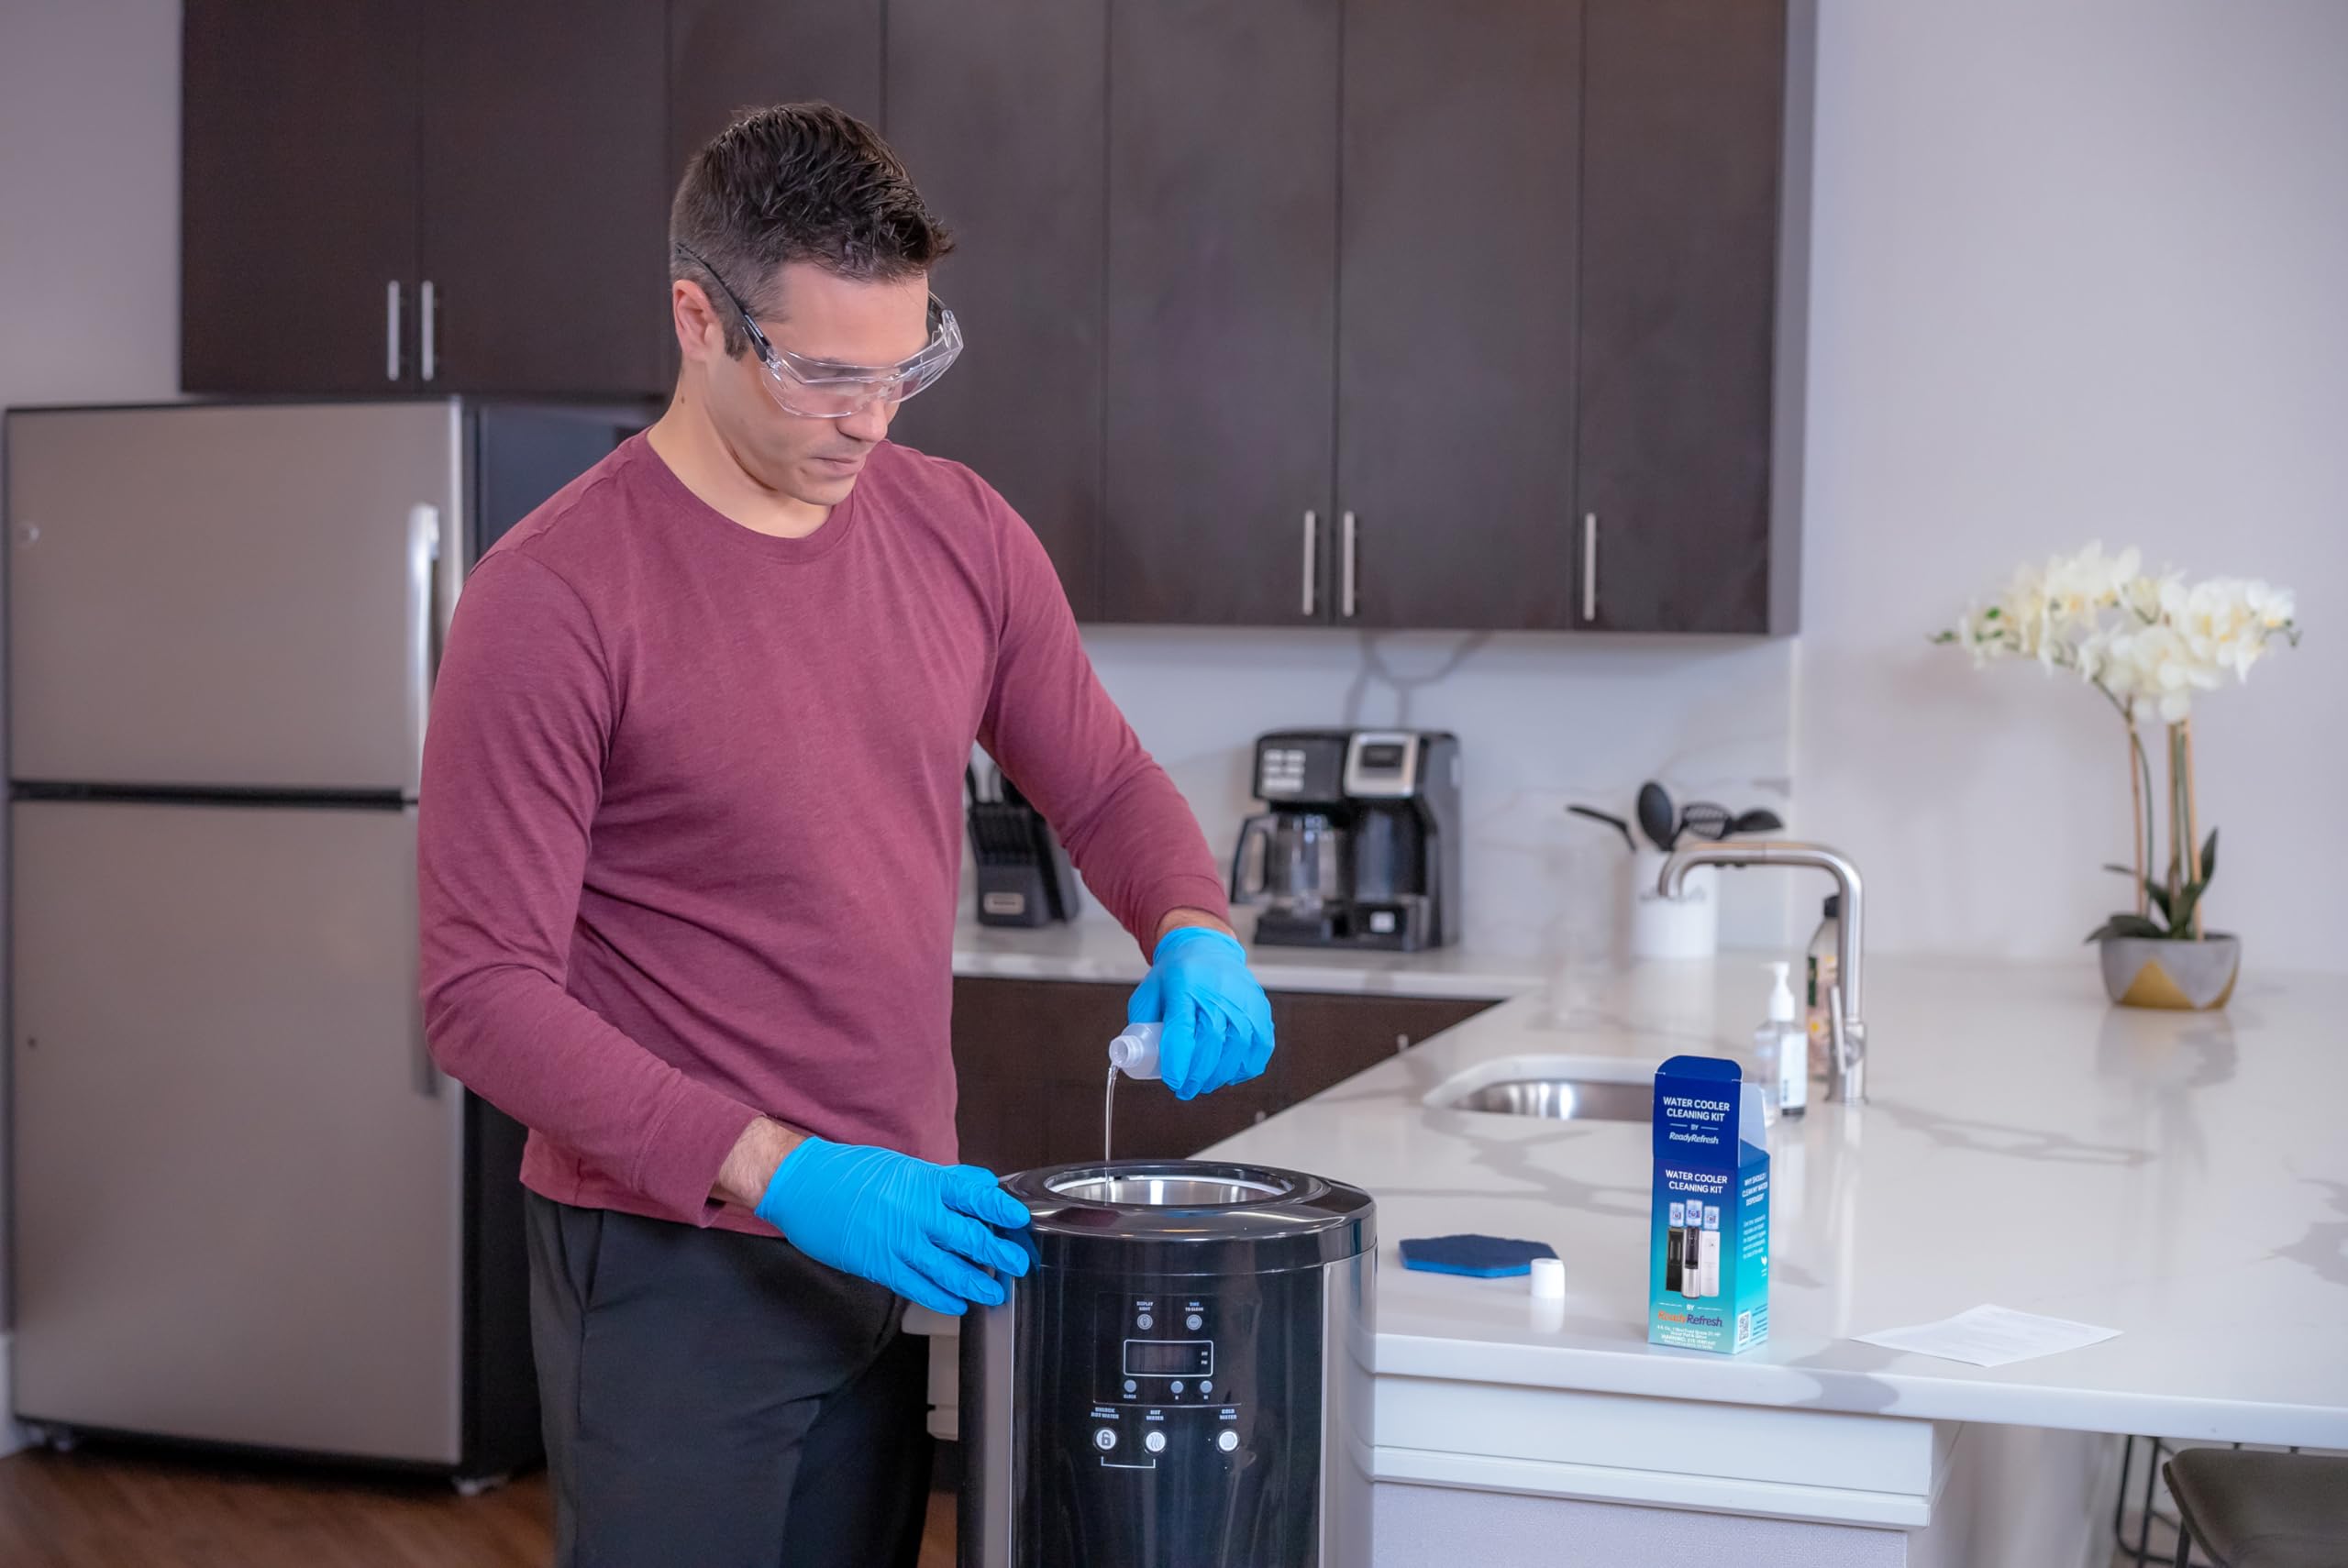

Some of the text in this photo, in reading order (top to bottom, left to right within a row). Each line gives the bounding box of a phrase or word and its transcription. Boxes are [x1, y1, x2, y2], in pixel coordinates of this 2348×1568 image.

[1663, 1096, 1730, 1111] WATER COOLER
[1667, 1108, 1725, 1122] CLEANING KIT
[1669, 1132, 1718, 1144] ReadyRefresh
[1666, 1170, 1728, 1183] WATER COOLER
[1669, 1181, 1723, 1194] CLEANING KIT
[1658, 1310, 1722, 1327] ReadyRefresh
